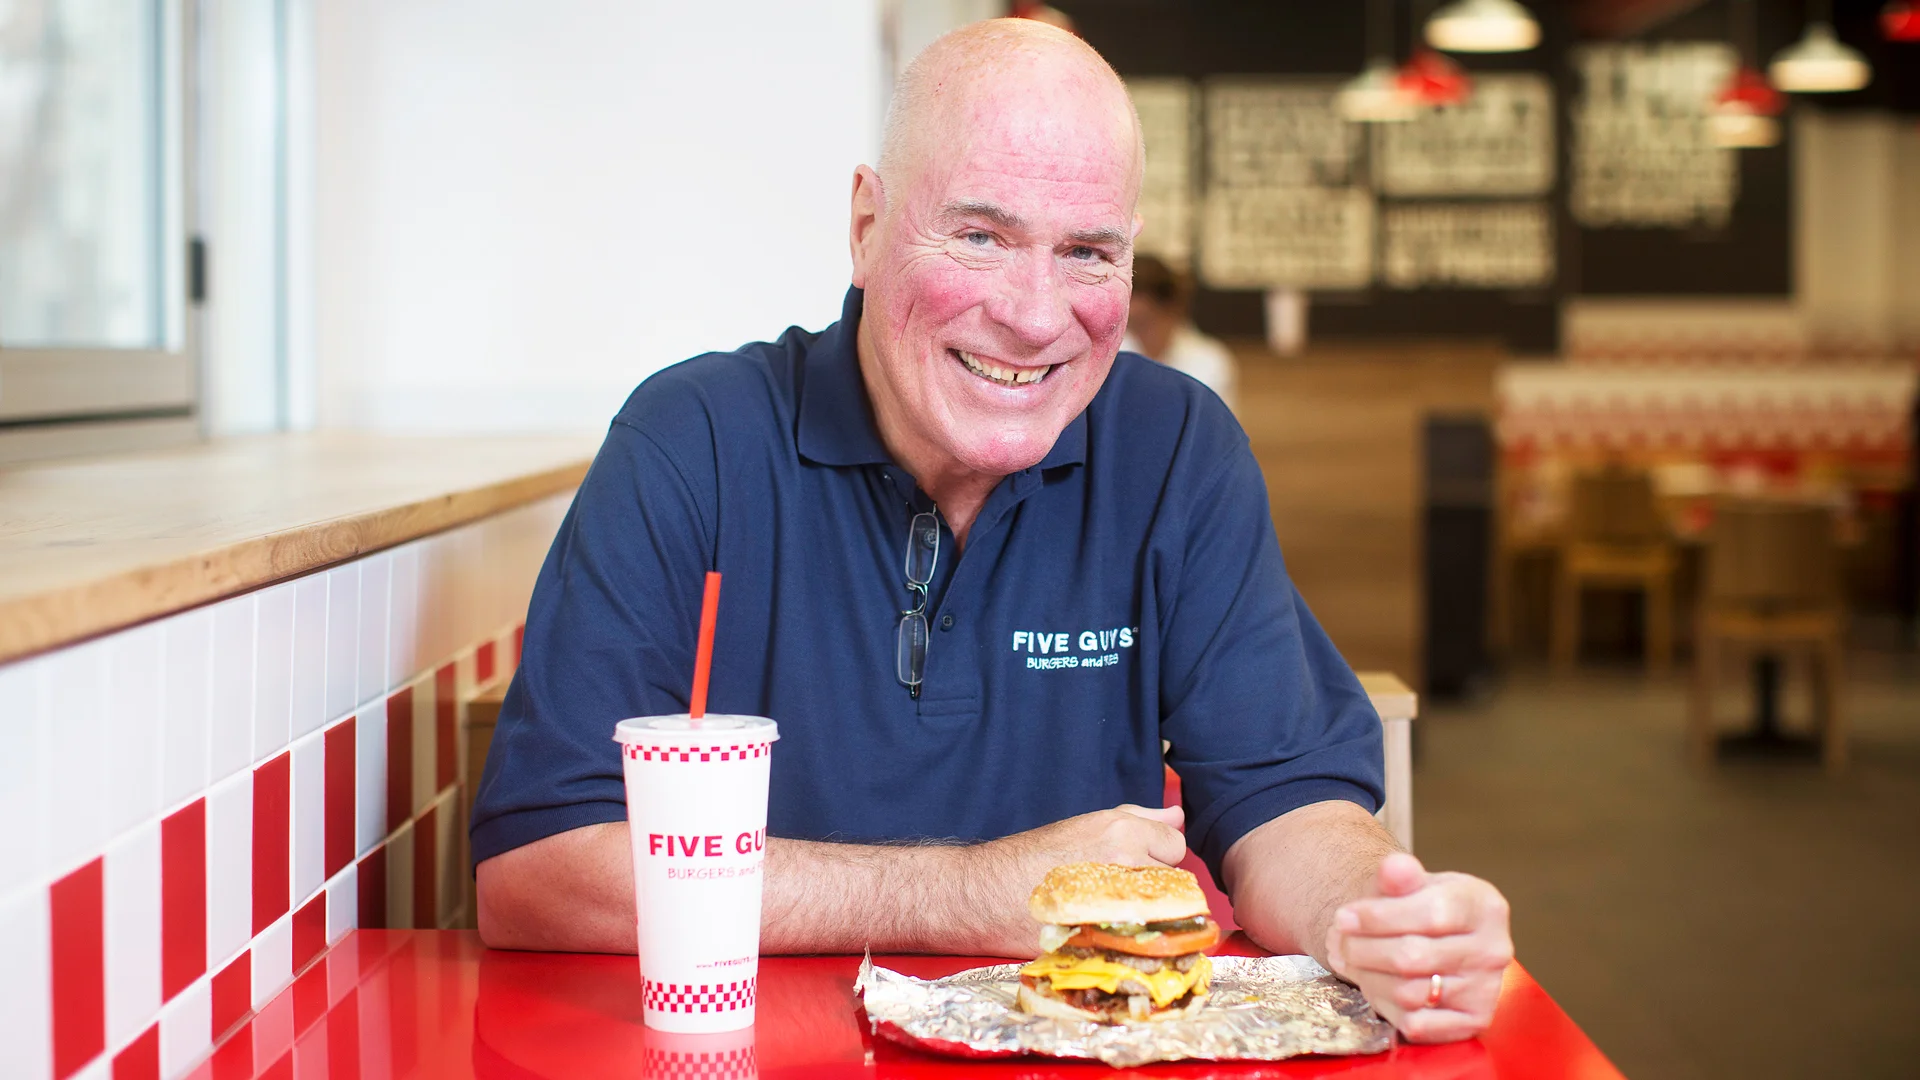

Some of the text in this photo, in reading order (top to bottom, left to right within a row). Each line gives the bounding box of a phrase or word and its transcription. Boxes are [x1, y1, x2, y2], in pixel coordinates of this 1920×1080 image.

[1013, 631, 1069, 654] FIVE
[1027, 656, 1078, 669] BURGERS
[1081, 656, 1103, 667] and
[649, 834, 723, 857] FIVE
[667, 867, 735, 880] BURGERS
[738, 865, 756, 877] and
